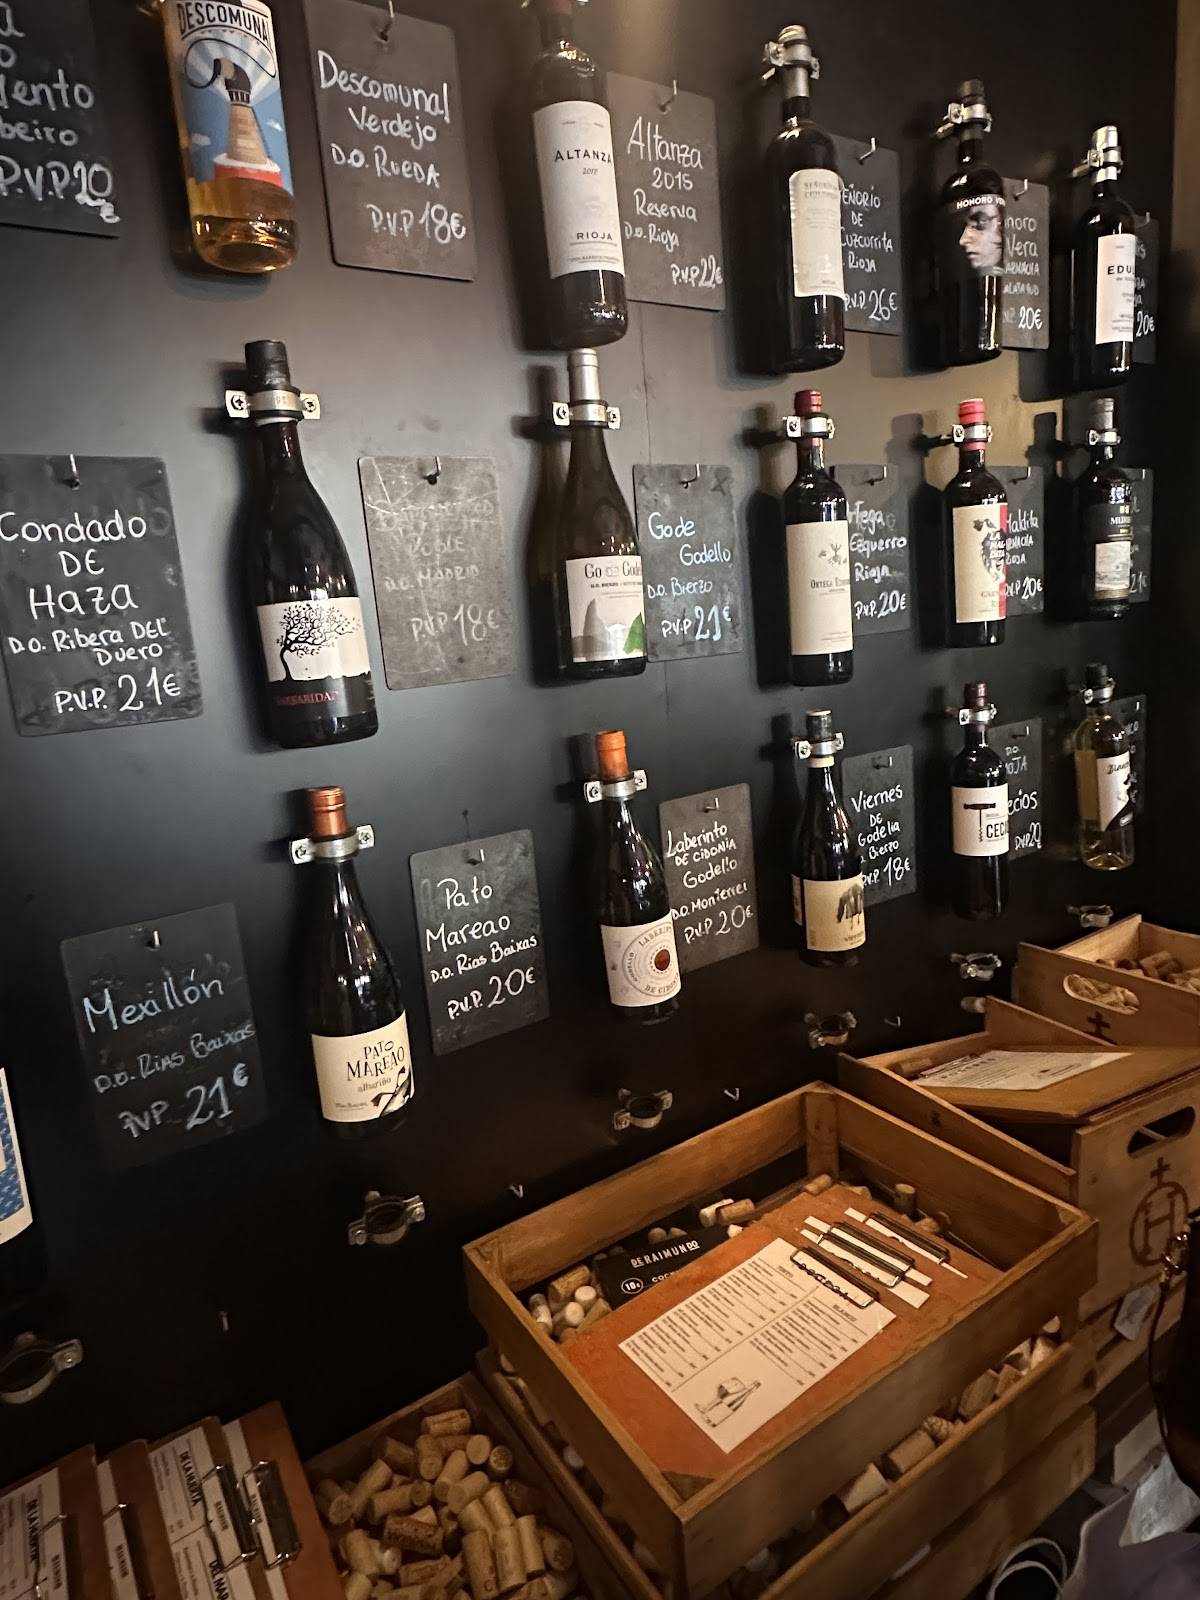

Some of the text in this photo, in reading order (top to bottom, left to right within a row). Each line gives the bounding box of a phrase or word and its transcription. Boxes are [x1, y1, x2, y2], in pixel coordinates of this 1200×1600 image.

[317, 50, 450, 124] Descomunal
[348, 105, 437, 150] Verdejo
[626, 115, 704, 169] Altanza
[554, 148, 614, 167] ALTANZA
[651, 167, 694, 190] 2015
[633, 187, 698, 222] Reserva
[852, 211, 864, 227] DE
[418, 200, 466, 244] 18€
[576, 231, 613, 241] RIOJA
[1003, 216, 1037, 232] noro
[1006, 234, 1039, 258] Vera
[1107, 265, 1136, 276] EDU
[868, 287, 899, 321] 26€
[1017, 305, 1044, 330] 20€
[1135, 310, 1156, 338] 20€
[0, 509, 147, 543] Condado
[57, 548, 105, 578] DE
[679, 541, 731, 567] Godello
[584, 563, 602, 579] Go
[29, 583, 139, 620] Haza
[670, 577, 713, 598] Bierzo
[1021, 576, 1043, 600] 20€
[876, 590, 907, 618] 20€
[453, 602, 501, 647] 18€
[693, 604, 731, 642] 21€
[52, 627, 123, 652] Ribera
[117, 666, 182, 712] 21€
[851, 784, 903, 813] Viernes
[1007, 788, 1038, 816] ecios
[857, 820, 900, 847] Godelia
[869, 812, 883, 828] DE
[666, 821, 728, 858] Laberinto
[675, 855, 690, 866] DE
[683, 856, 738, 889] Godello
[882, 857, 911, 886] 18€
[437, 876, 493, 910] Pato
[426, 915, 510, 952] Mareao
[715, 904, 754, 936] 20€
[490, 935, 537, 964] Baixas
[83, 968, 225, 1033] Mexillón
[487, 967, 536, 1008] 20€
[346, 1046, 405, 1082] MAREAO
[364, 1040, 394, 1060] PATO
[185, 1062, 250, 1131] 21€
[643, 1240, 700, 1265] RAIMUNDO
